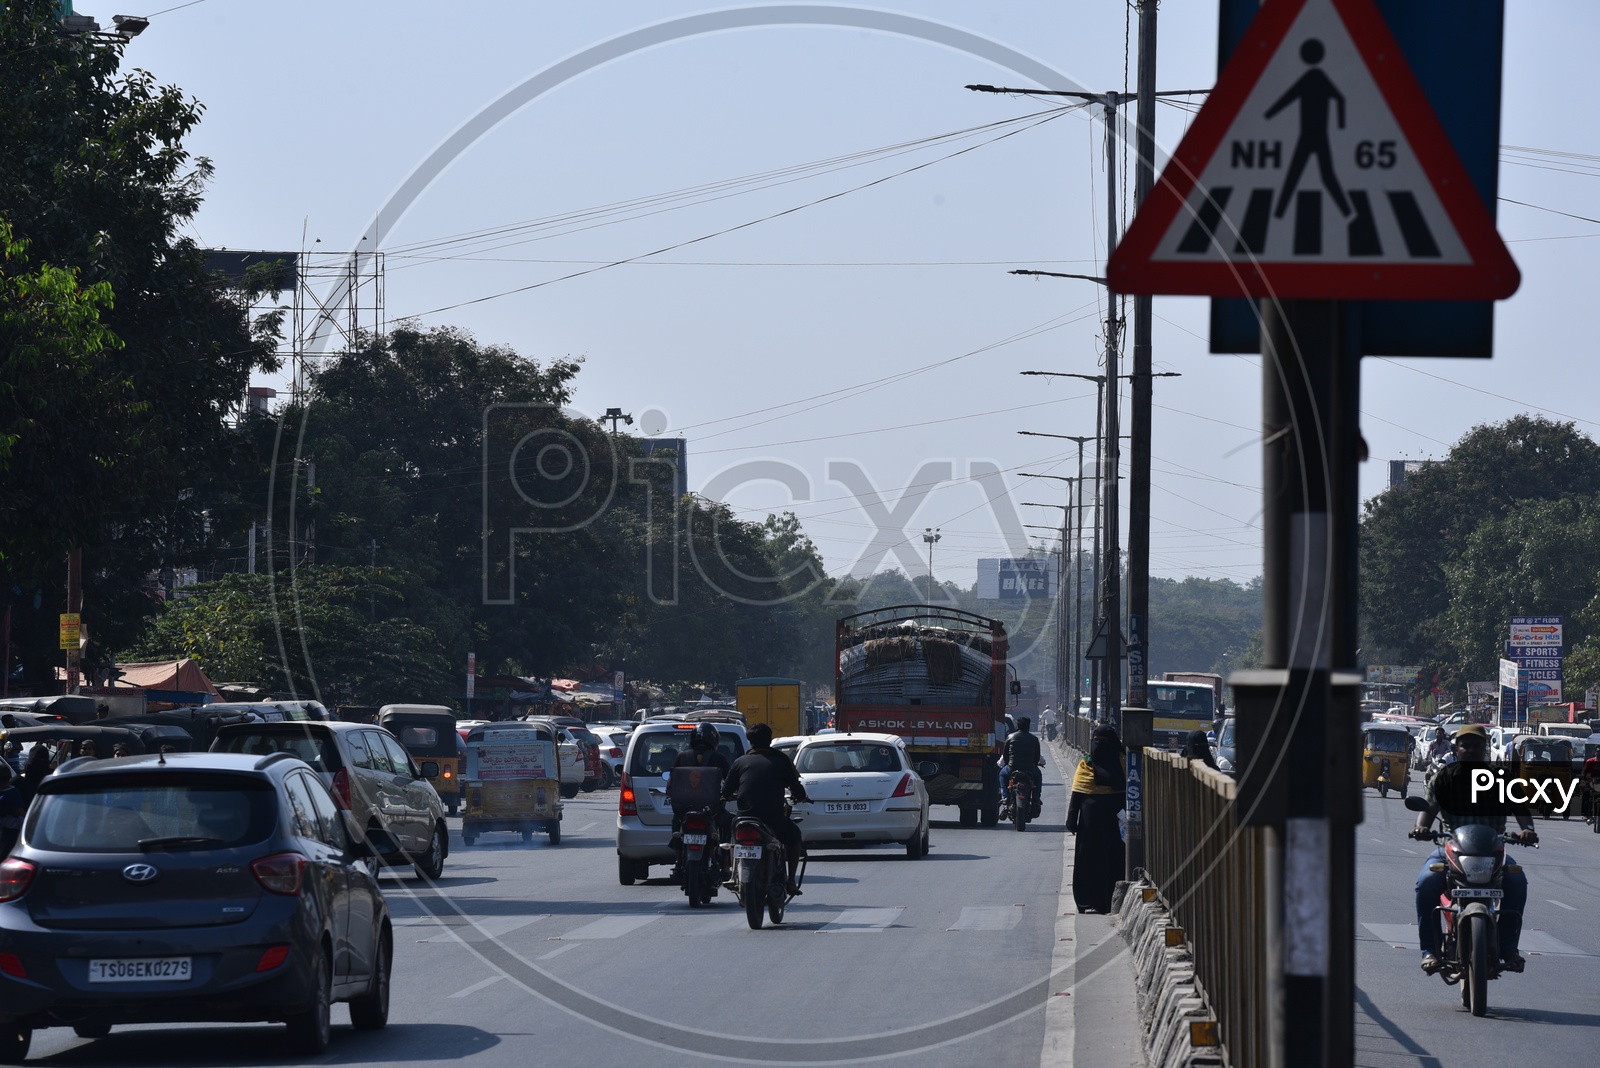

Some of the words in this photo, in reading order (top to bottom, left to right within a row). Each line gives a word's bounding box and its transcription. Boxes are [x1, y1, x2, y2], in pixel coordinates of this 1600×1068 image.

[1230, 140, 1282, 169] NH
[1355, 140, 1397, 170] 65
[1525, 647, 1558, 656] SPORTS
[1525, 659, 1560, 668] FITNESS
[858, 720, 905, 729] ASHOK
[910, 721, 973, 730] LEYLAND
[836, 803, 843, 811] 15
[98, 961, 189, 977] TS06EK0279
